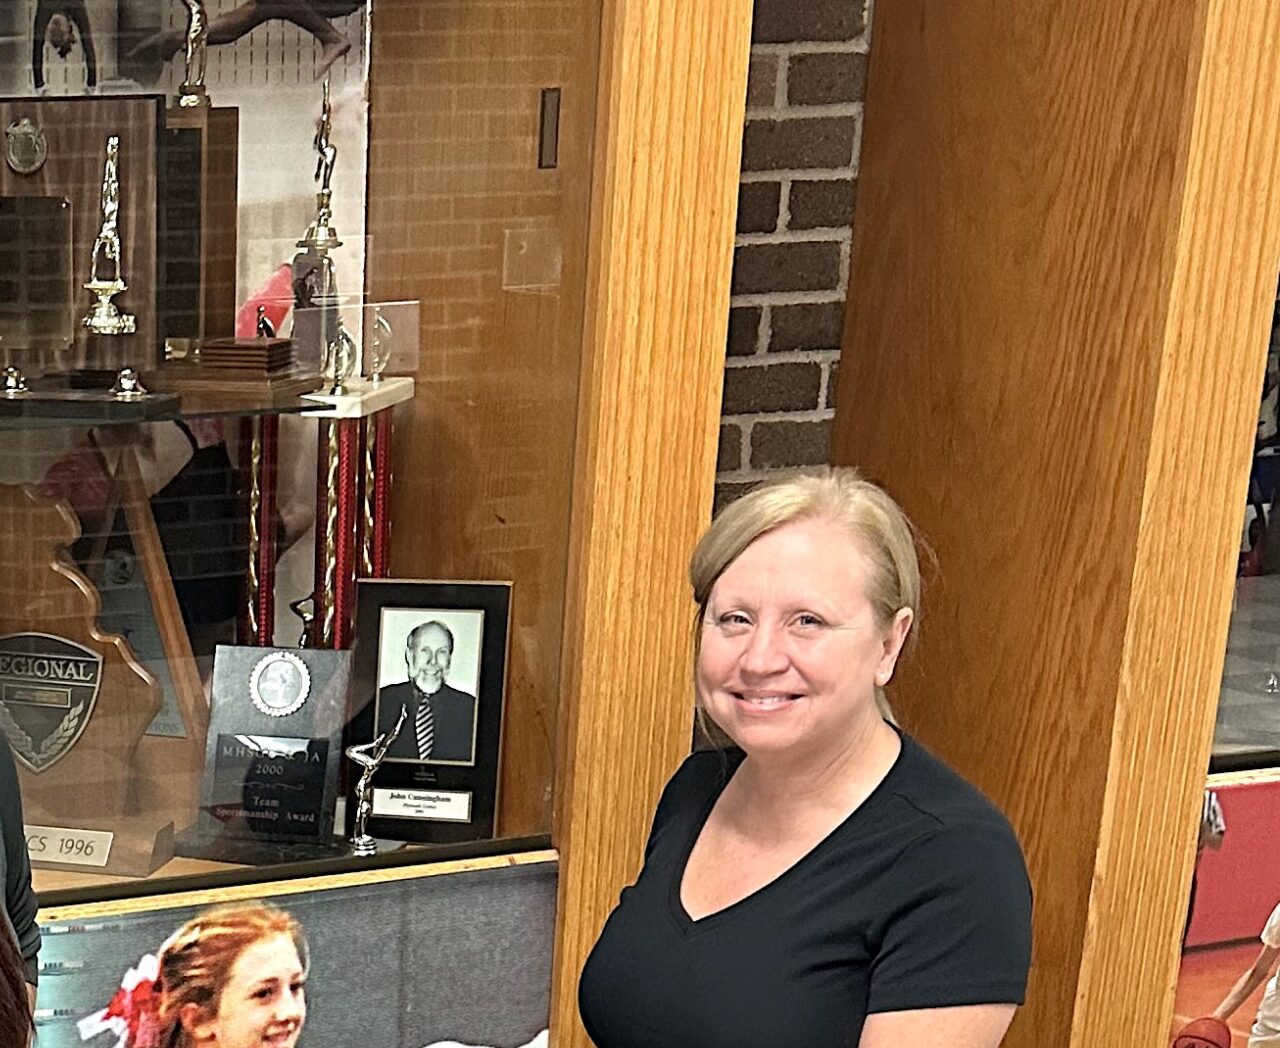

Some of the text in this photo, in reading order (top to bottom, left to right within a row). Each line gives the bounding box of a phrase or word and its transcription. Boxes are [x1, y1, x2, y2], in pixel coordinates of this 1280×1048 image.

[255, 764, 284, 775] 2000
[253, 796, 280, 807] Team
[286, 811, 314, 822] Award
[27, 835, 96, 856] CS 1996
